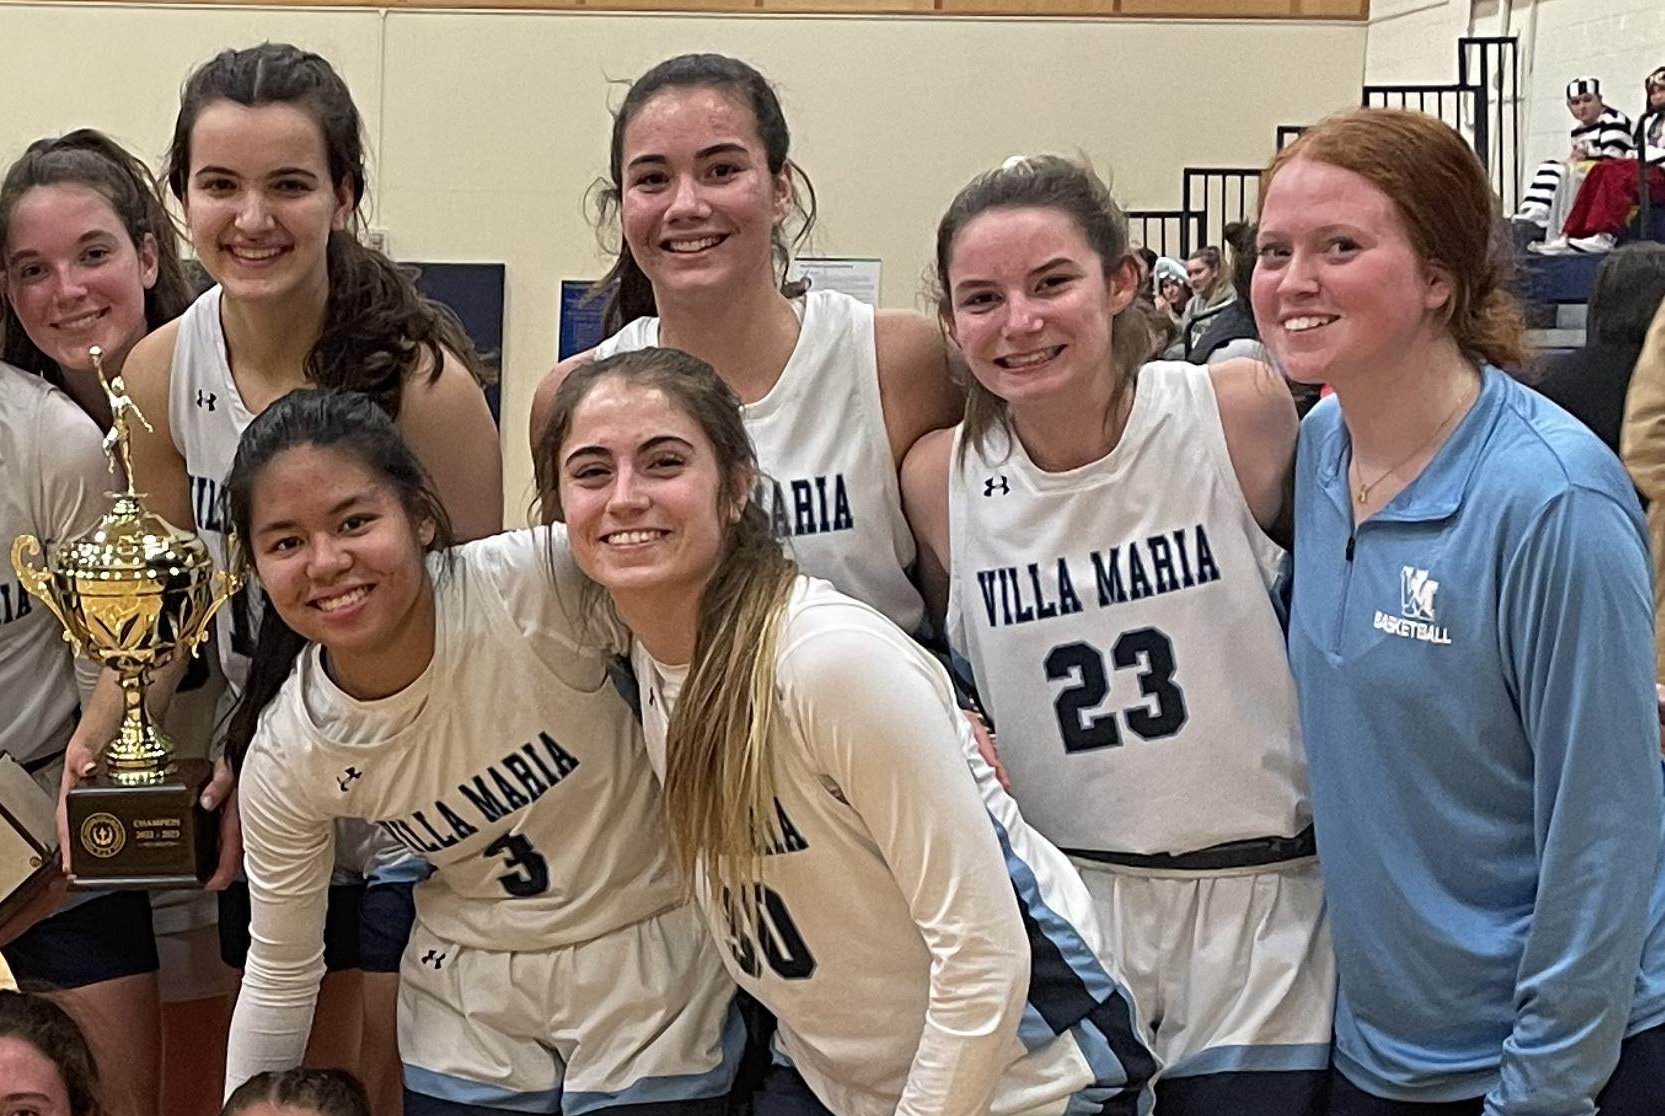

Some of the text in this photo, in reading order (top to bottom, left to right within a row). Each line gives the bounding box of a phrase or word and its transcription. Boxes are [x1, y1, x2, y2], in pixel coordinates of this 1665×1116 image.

[754, 473, 854, 538] ARIA
[977, 523, 1221, 627] VILLA MARIA
[1373, 609, 1452, 645] BASKETBALL
[1043, 625, 1189, 755] 23
[458, 731, 580, 823] MARIA
[483, 832, 550, 898] 3
